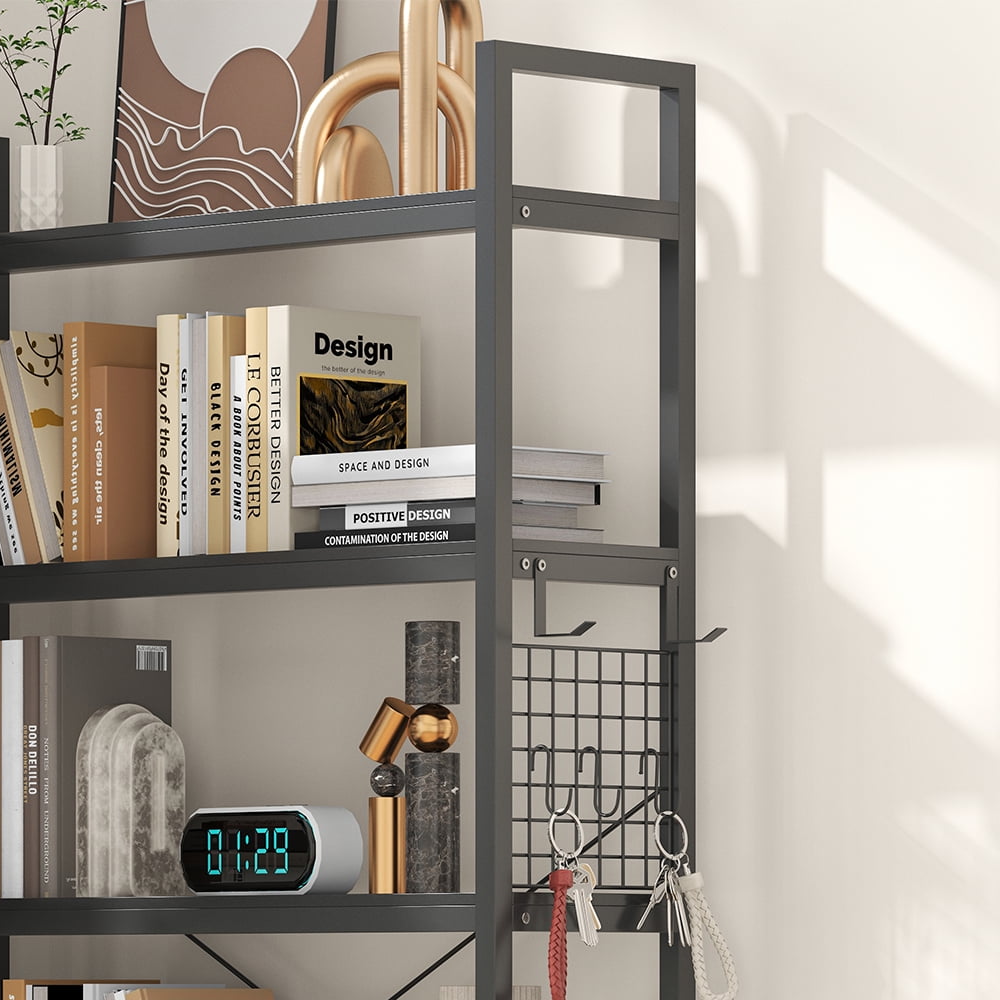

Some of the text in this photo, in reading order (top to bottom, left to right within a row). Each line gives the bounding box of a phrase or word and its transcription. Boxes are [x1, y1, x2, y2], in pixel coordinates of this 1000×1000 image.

[315, 332, 392, 365] Design
[158, 363, 170, 525] Day of the design
[210, 383, 221, 495] BLACK DESIGN
[247, 353, 261, 519] LE CORBUSIER
[271, 367, 281, 503] BETTER DESIGN
[339, 458, 429, 472] SPACE AND DESIGN
[325, 530, 448, 546] CONTAMINATION OF THE DESIGN
[354, 509, 450, 523] POSITIVE DESIGN
[29, 726, 37, 794] DON DELILLO
[208, 828, 288, 874] 01:29
